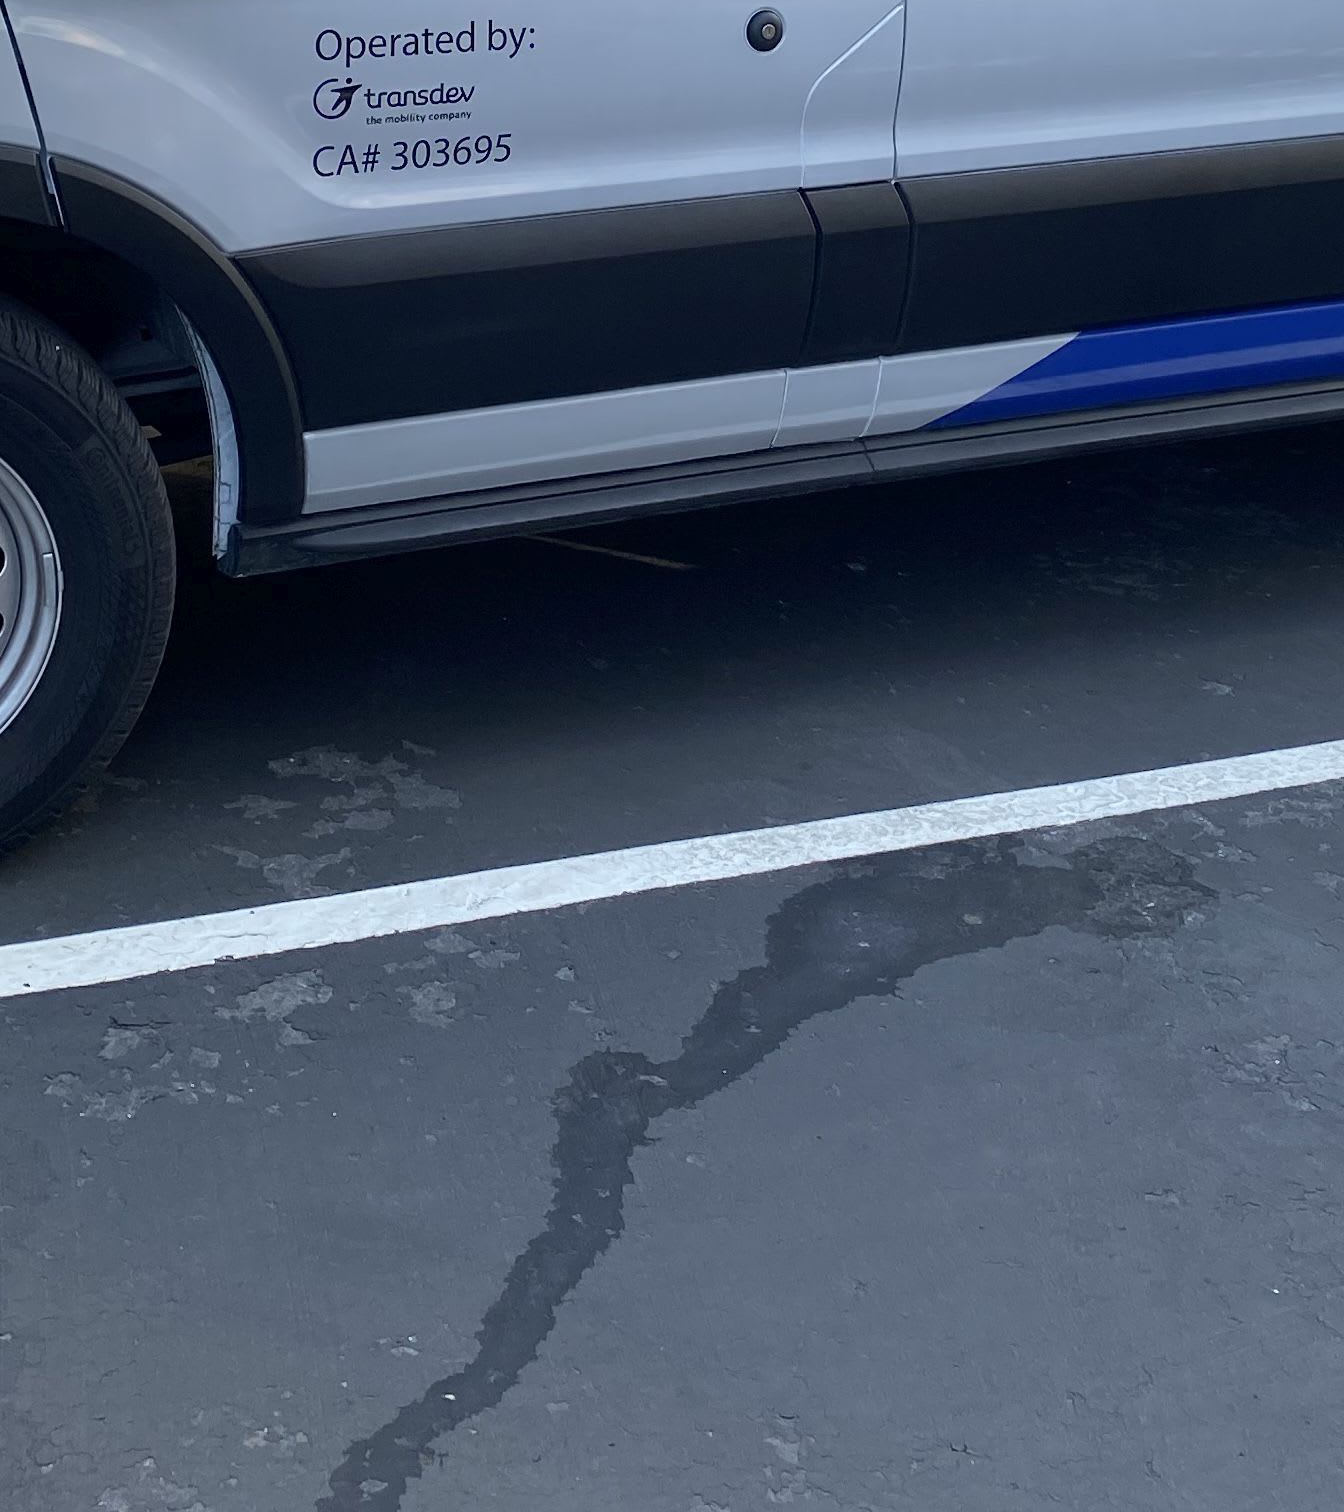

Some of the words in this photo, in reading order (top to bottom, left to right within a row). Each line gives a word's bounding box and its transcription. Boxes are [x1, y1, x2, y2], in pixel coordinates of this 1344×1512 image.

[314, 20, 476, 68] Operated
[487, 19, 536, 59] by:
[363, 82, 475, 109] transdev
[366, 116, 382, 125] the
[384, 113, 426, 124] mobility
[428, 111, 472, 122] company
[312, 143, 381, 177] CA#
[390, 133, 512, 171] 303695
